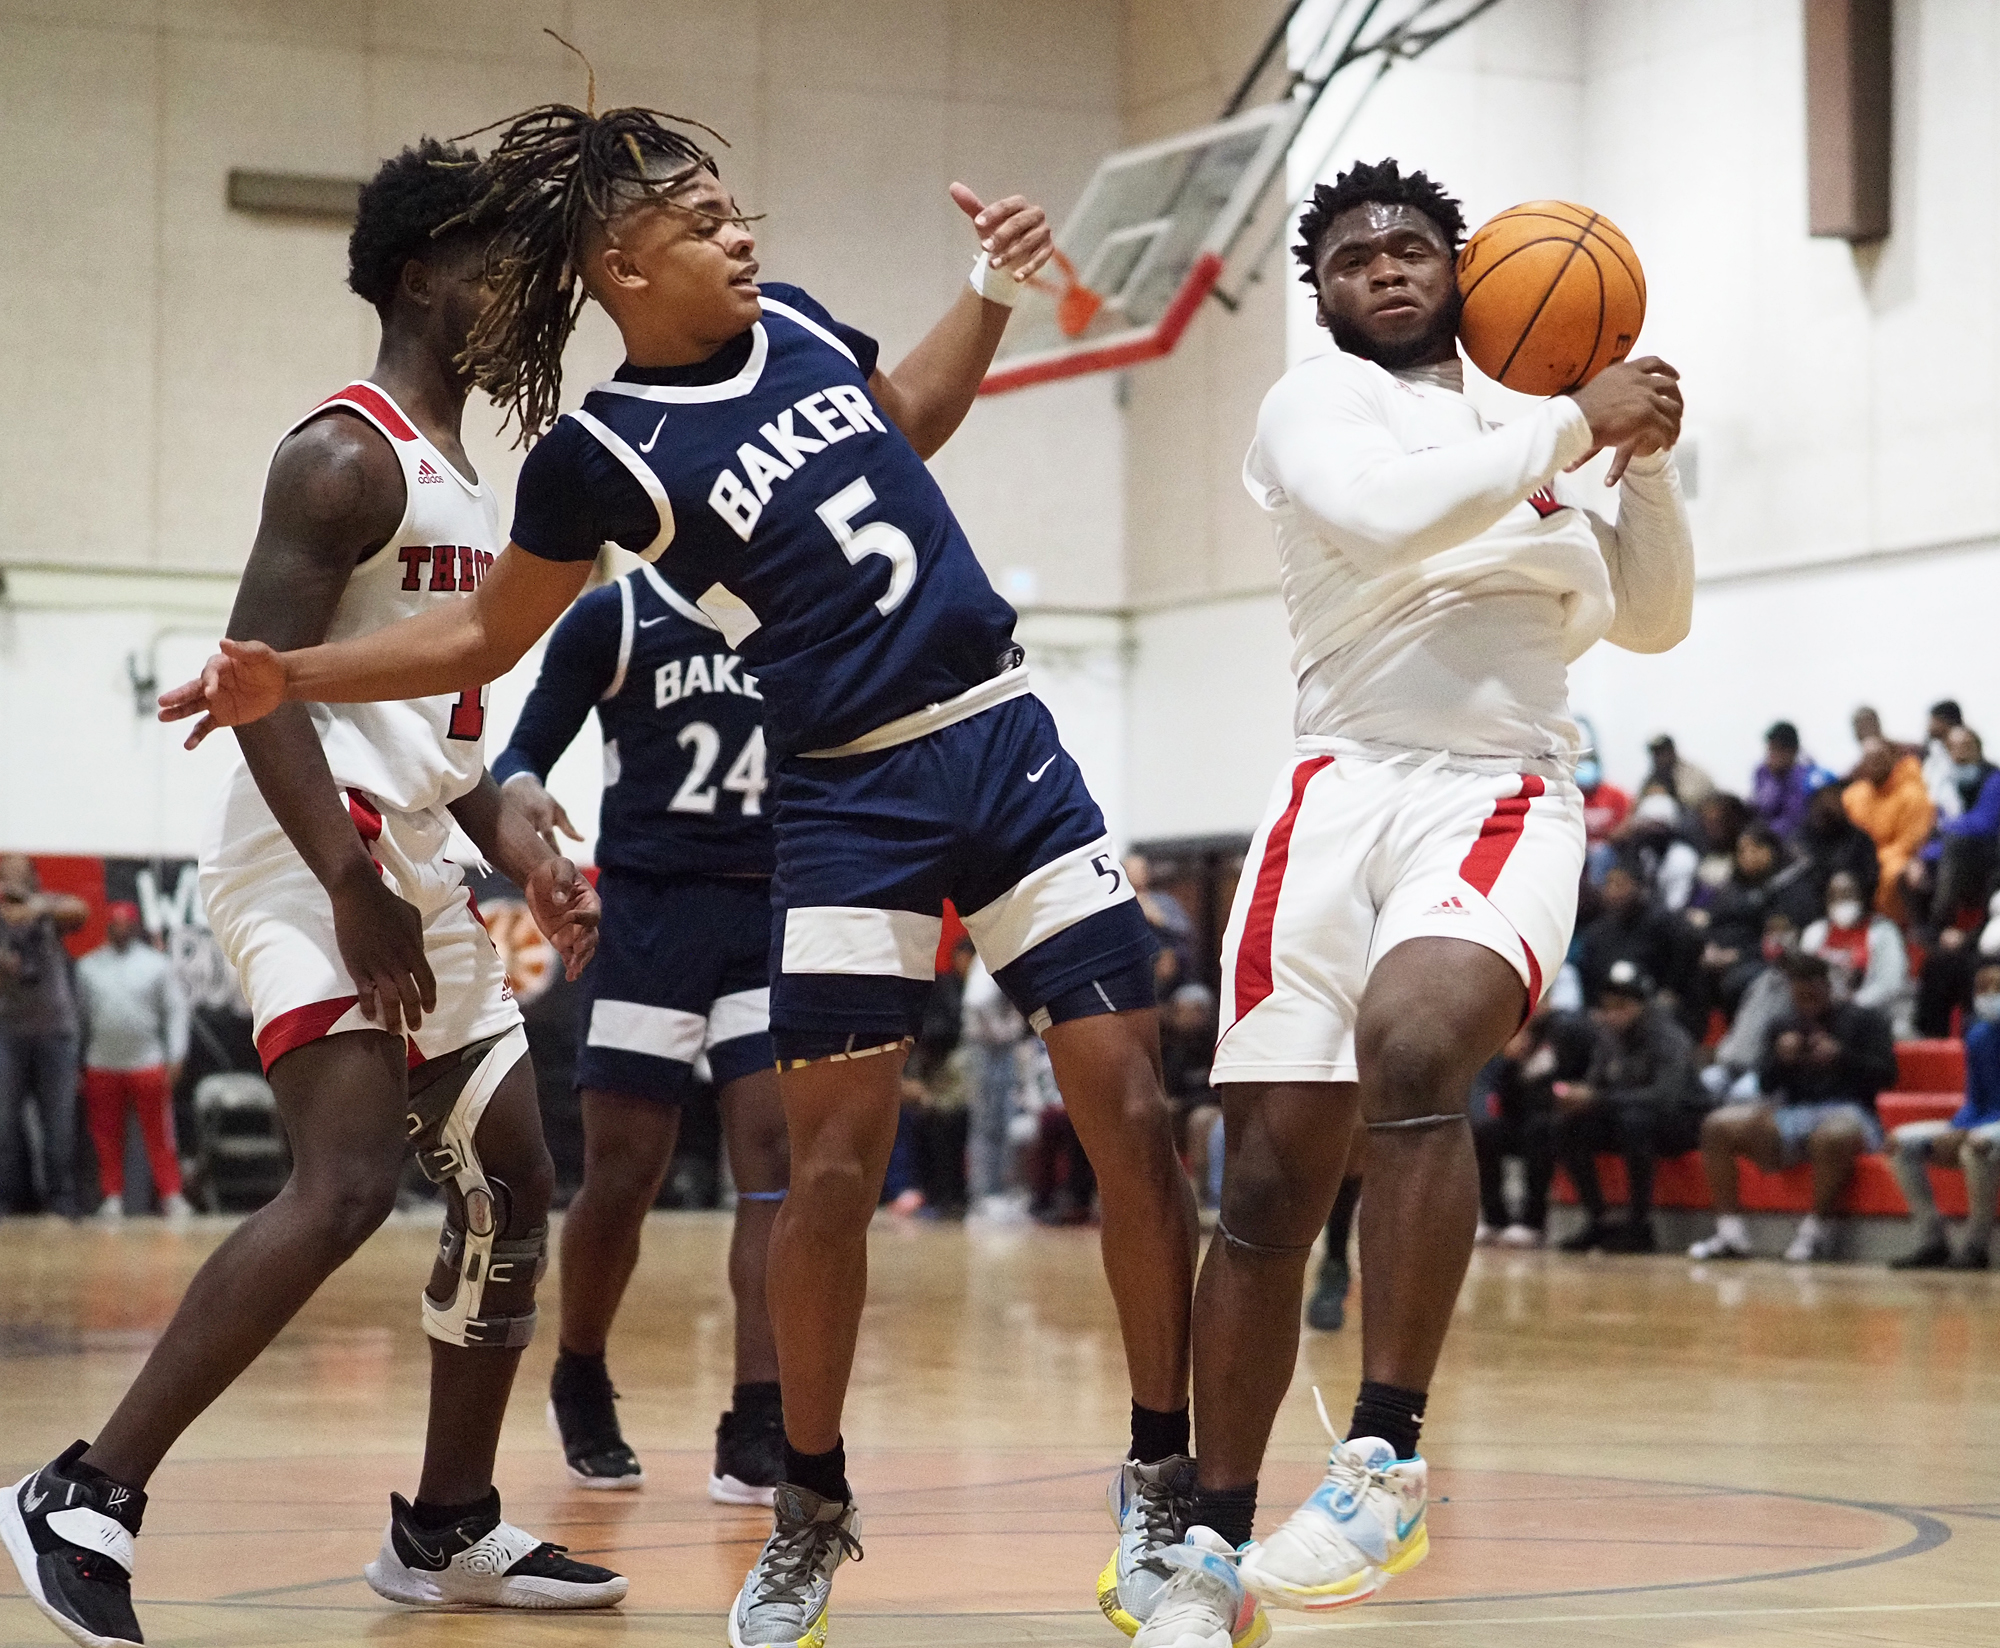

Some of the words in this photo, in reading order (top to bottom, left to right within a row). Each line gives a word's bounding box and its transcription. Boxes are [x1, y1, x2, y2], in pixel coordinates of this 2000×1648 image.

[417, 474, 445, 485] adidas
[707, 384, 888, 543] BAKER
[814, 475, 918, 618] 5
[667, 720, 769, 816] 24
[1090, 853, 1121, 895] 5
